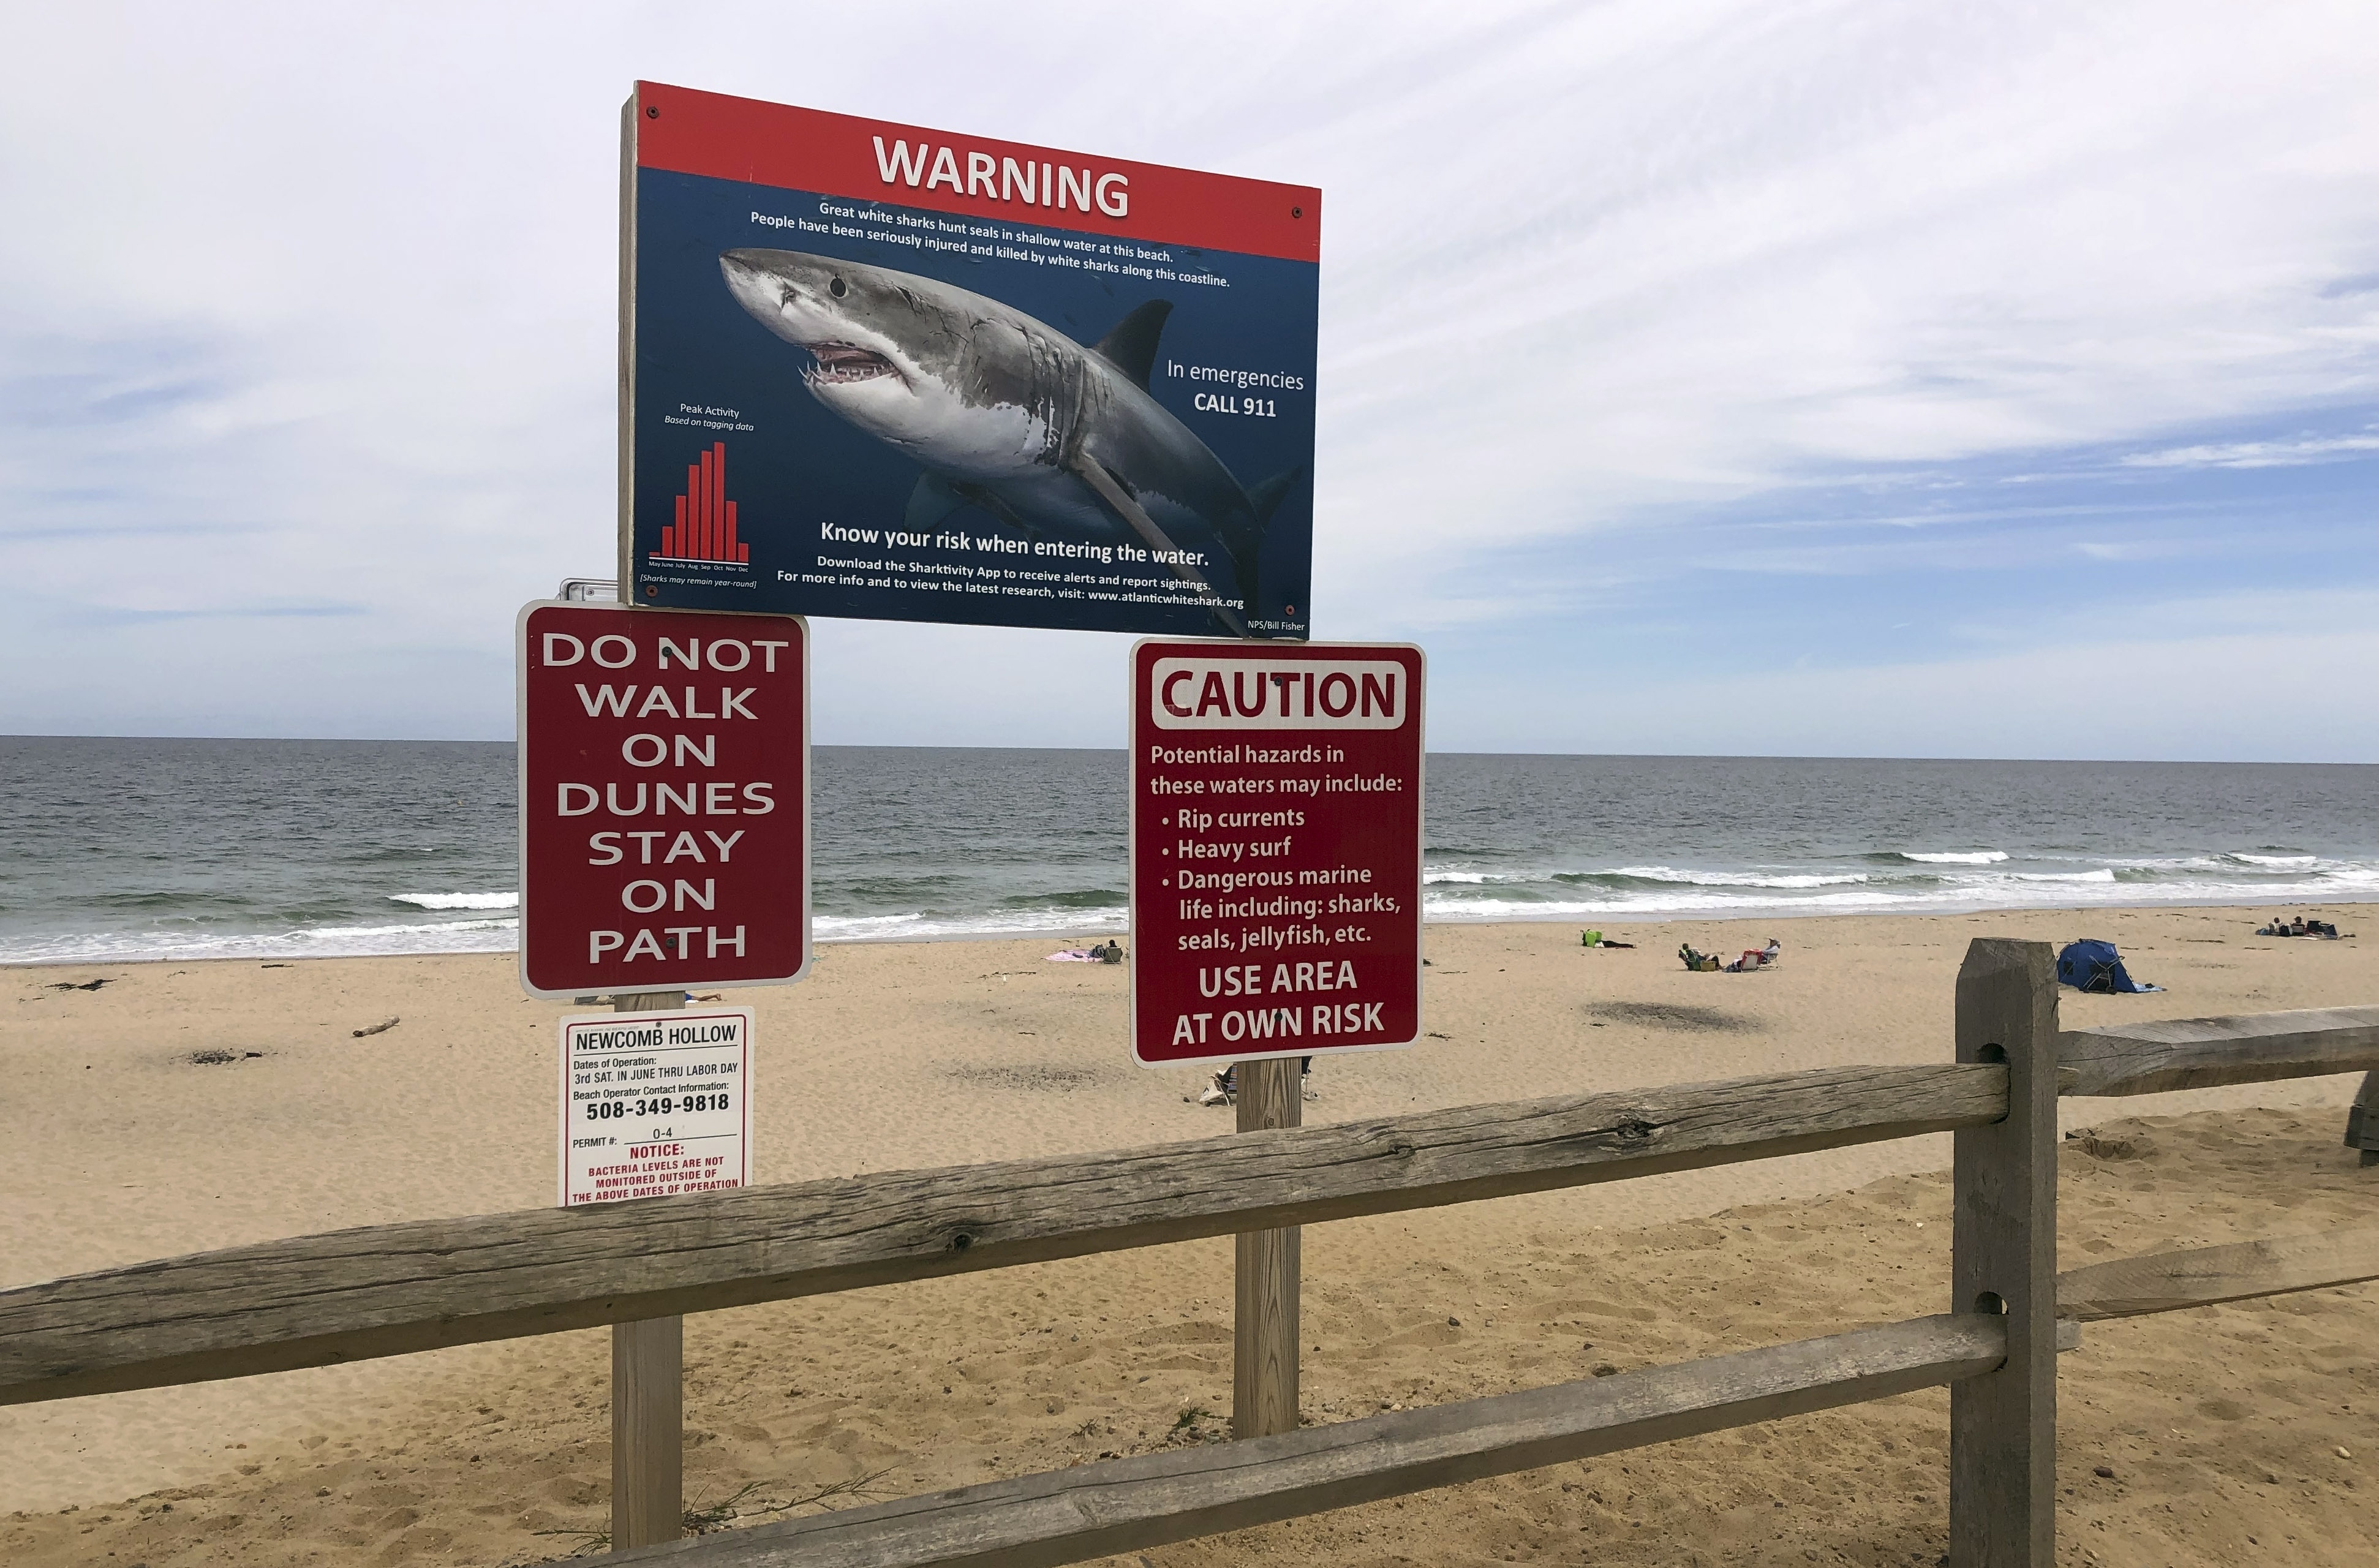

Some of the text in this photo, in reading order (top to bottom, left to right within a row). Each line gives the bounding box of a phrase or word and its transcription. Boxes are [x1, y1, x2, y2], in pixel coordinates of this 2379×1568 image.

[873, 136, 1128, 216] WARNING
[820, 202, 1174, 263] Great white sharks hunt seals in shallow water at this beach.
[751, 211, 1230, 287] People have been seriously injured and killed by white sharks along this coastline.
[1168, 359, 1304, 390] In emergencies
[681, 403, 740, 420] Peak Activity
[1194, 393, 1276, 417] CALL 911
[665, 415, 690, 425] Based
[703, 420, 734, 431] tagging
[735, 422, 754, 431] data
[821, 522, 1208, 566] Know your risk when entering the water.
[639, 573, 668, 582] [Sharks
[714, 580, 757, 589] year-round]
[818, 556, 1211, 592] Download the Sharktivity App to receive alerts and report sightings.
[777, 570, 1244, 610] For more info and to view the latest research, visit: www.atlanticwhiteshark.org
[1248, 620, 1305, 631] NPS/Bill Fisher
[543, 633, 788, 672] DO NOT
[575, 684, 758, 719] WALK
[1162, 671, 1395, 717] CAUTION
[622, 734, 714, 767] ON
[1152, 745, 1343, 763] Potential hazards in
[1151, 774, 1401, 797] these waters may include:
[559, 783, 774, 816] DUNES
[1179, 809, 1304, 832] Rip currents
[589, 831, 745, 865] STAY
[1179, 836, 1291, 862] Heavy surf
[1179, 865, 1371, 892] Dangerous marine
[622, 879, 714, 913] ON
[1181, 892, 1400, 919] life including: sharks,
[590, 925, 745, 963] PATH
[1178, 924, 1371, 952] seals, jellyfish, etc.
[1200, 960, 1357, 997] USE AREA
[576, 1024, 737, 1050] NEWCOMB HOLLOW
[1172, 1003, 1384, 1045] AT OWN RISK
[573, 1056, 657, 1070] Dates of Operation:
[575, 1062, 738, 1085] 3rd SAT. IN JUNE THRU LABOR DAY
[573, 1081, 729, 1101] Beach Operator Contact Information:
[586, 1093, 729, 1120] 508-349-9818
[573, 1137, 607, 1148] PERMIT
[608, 1136, 617, 1145] #:
[630, 1143, 684, 1159] NOTICE:
[589, 1156, 724, 1177] BACTERIA LEVELS ARE NOT
[596, 1169, 717, 1188] MONITORED OUTSIDE OF
[572, 1178, 739, 1203] THE ABOVE DATES OF OPERATION
